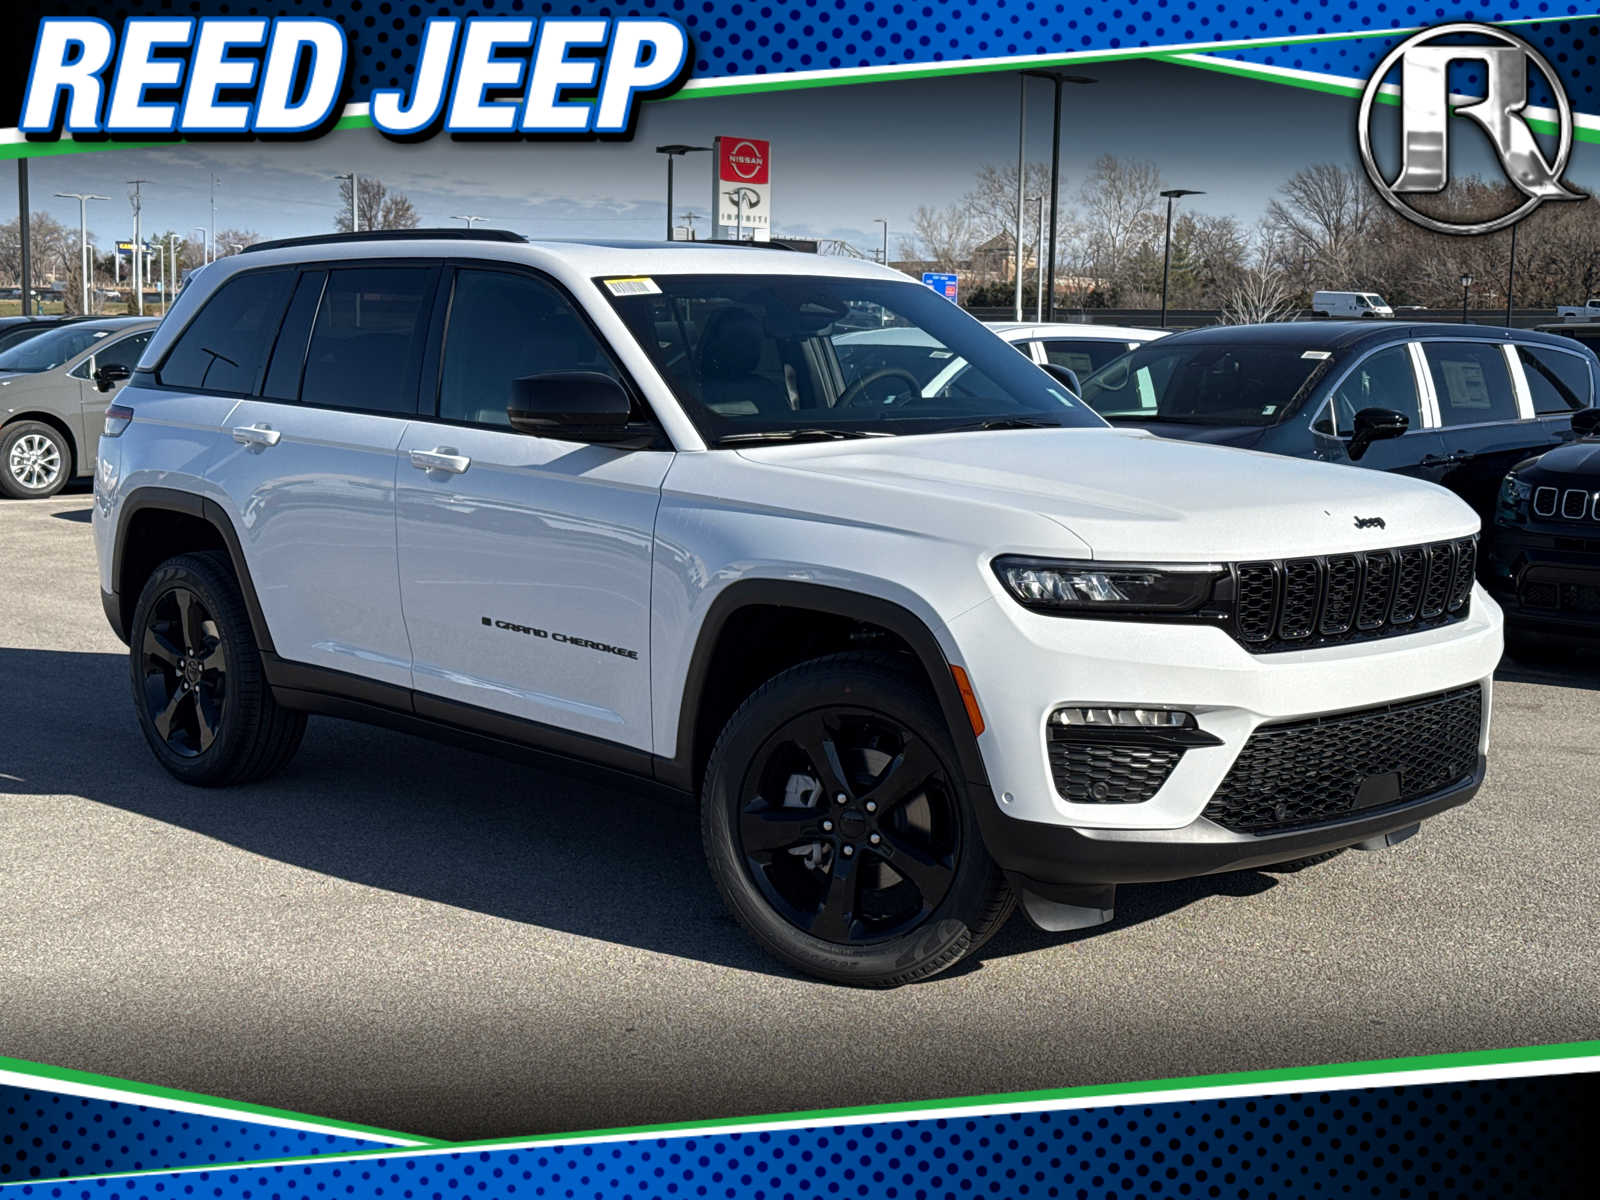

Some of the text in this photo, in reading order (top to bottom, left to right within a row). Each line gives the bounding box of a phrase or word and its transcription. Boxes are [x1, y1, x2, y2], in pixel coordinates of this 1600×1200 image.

[729, 154, 763, 165] NISSAN
[1353, 515, 1386, 530] Jeep
[495, 620, 638, 660] GRAND CHEROKEE
